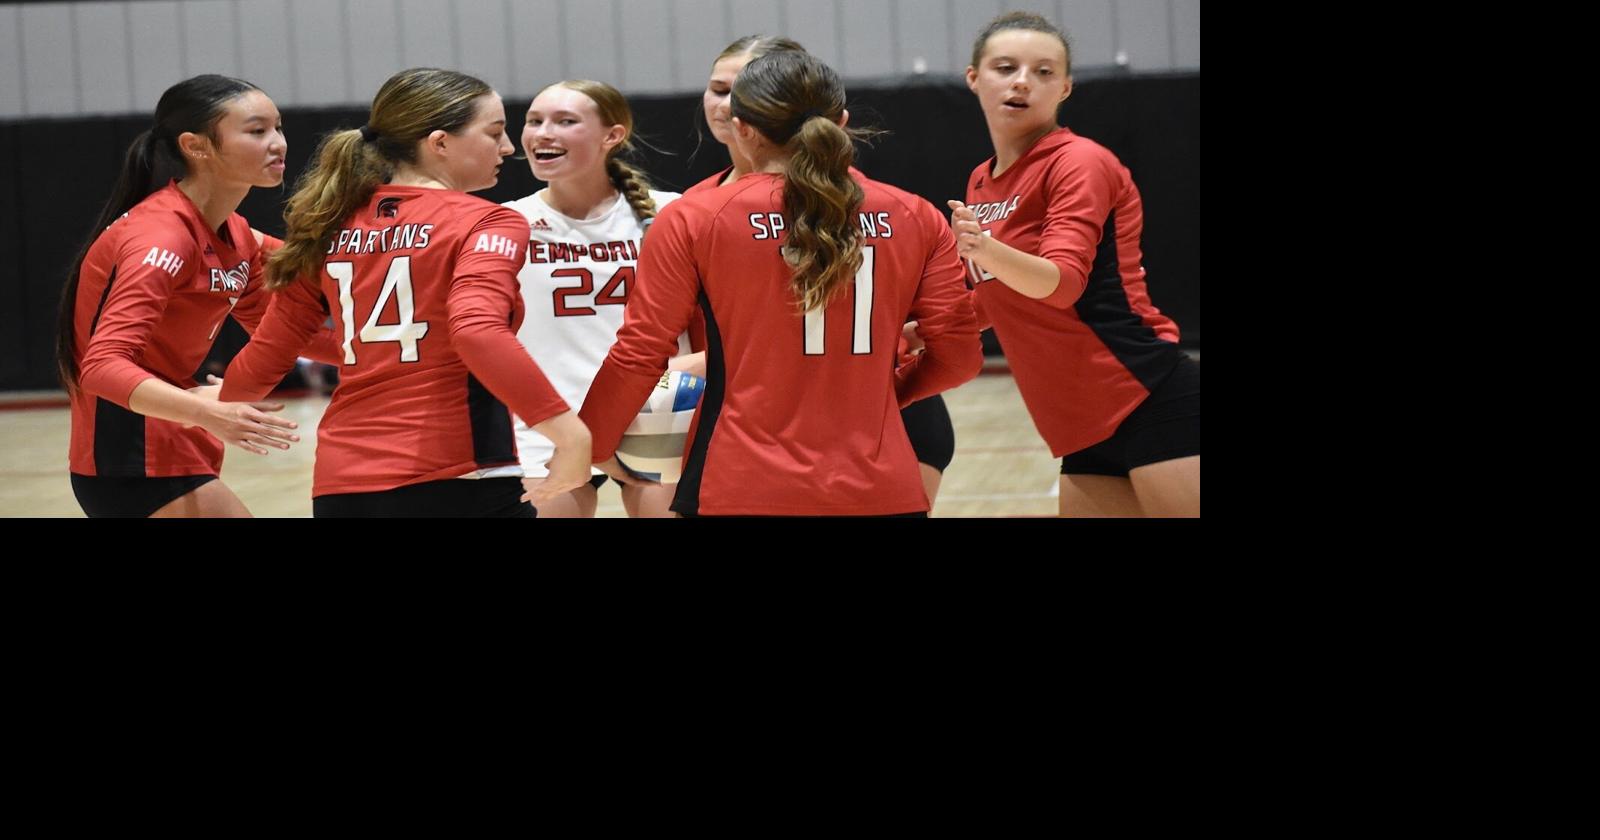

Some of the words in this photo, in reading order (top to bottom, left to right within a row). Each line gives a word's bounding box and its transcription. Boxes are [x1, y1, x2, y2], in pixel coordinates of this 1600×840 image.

[750, 212, 893, 240] SPNS
[142, 246, 184, 278] AHH
[475, 233, 518, 260] AHH
[529, 239, 643, 264] EMPORI
[550, 266, 637, 318] 24
[779, 245, 876, 356] 11
[325, 255, 430, 367] 14
